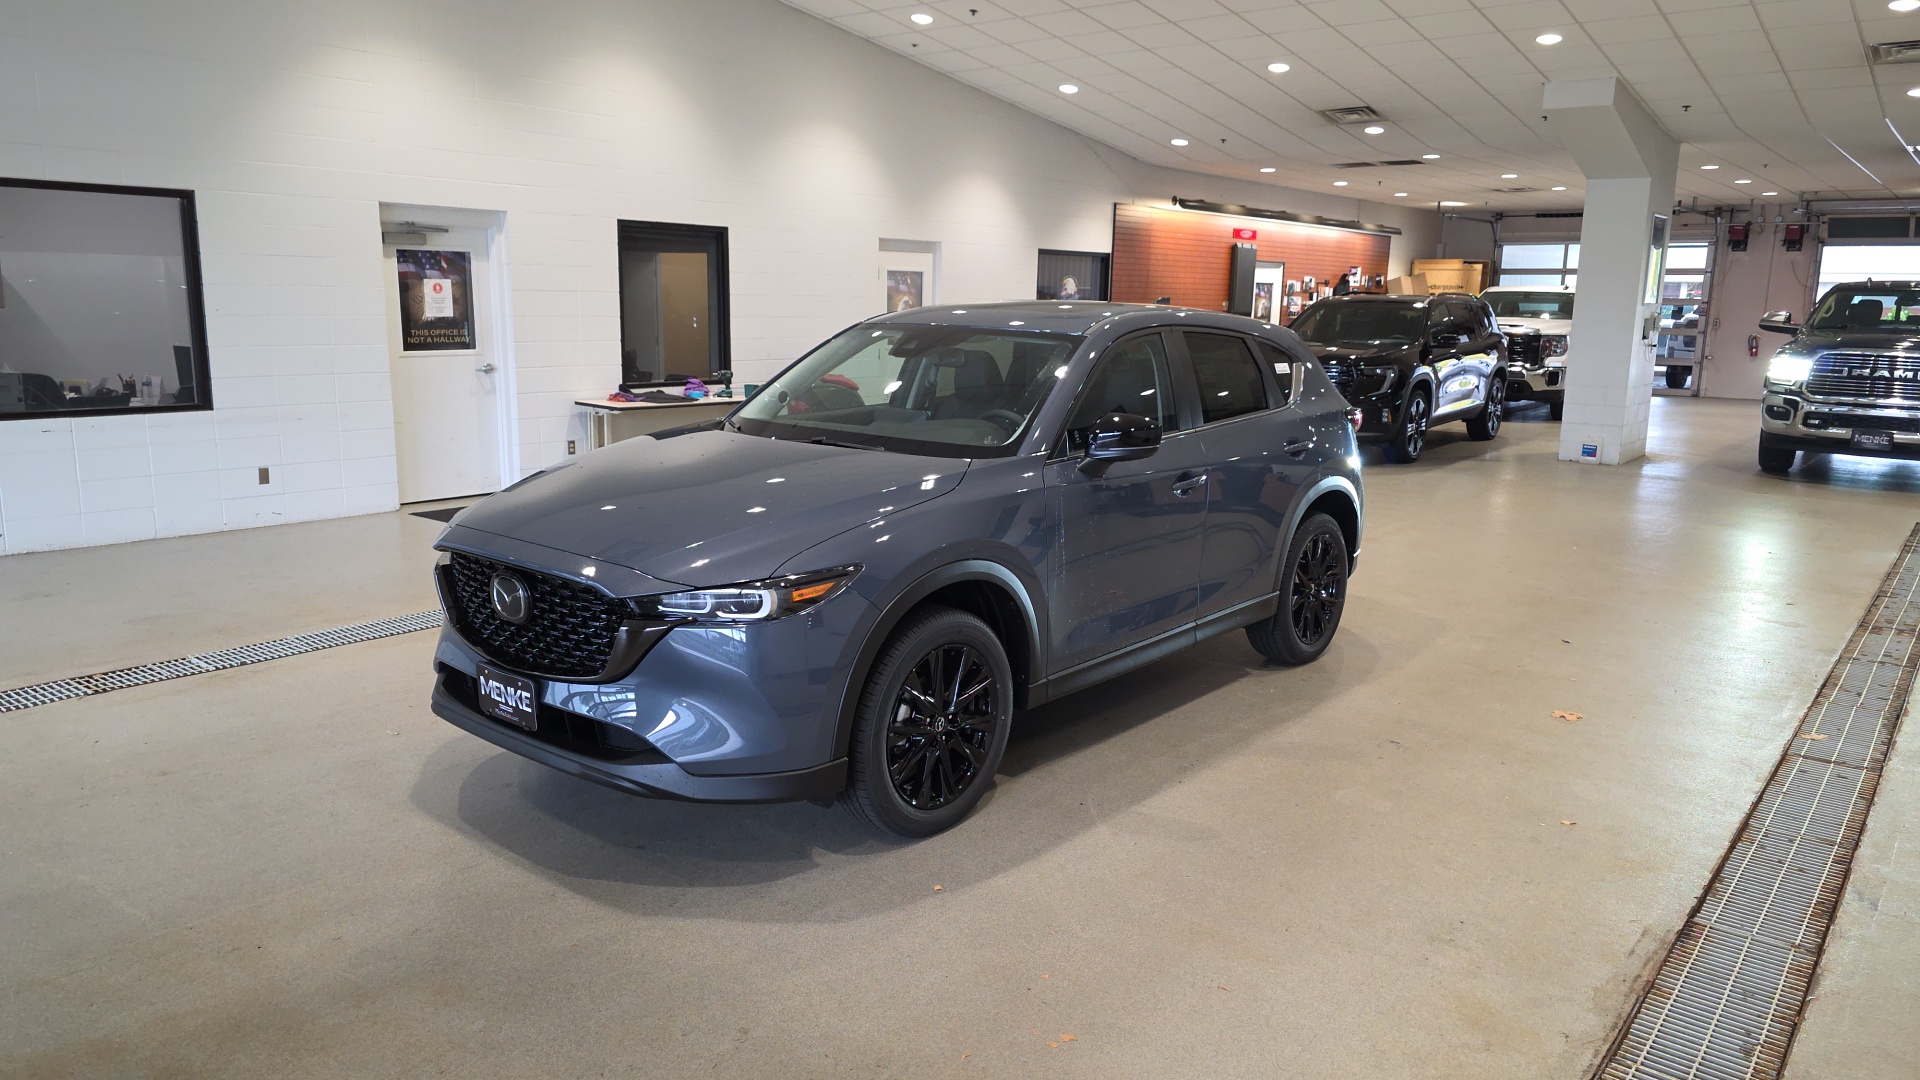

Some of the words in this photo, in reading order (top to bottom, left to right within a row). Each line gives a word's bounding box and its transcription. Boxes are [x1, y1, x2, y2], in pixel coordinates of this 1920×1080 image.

[433, 335, 470, 344] HALLWAY
[1851, 368, 1914, 379] RAM
[1854, 434, 1890, 445] MENKE
[479, 675, 532, 713] MENKE
